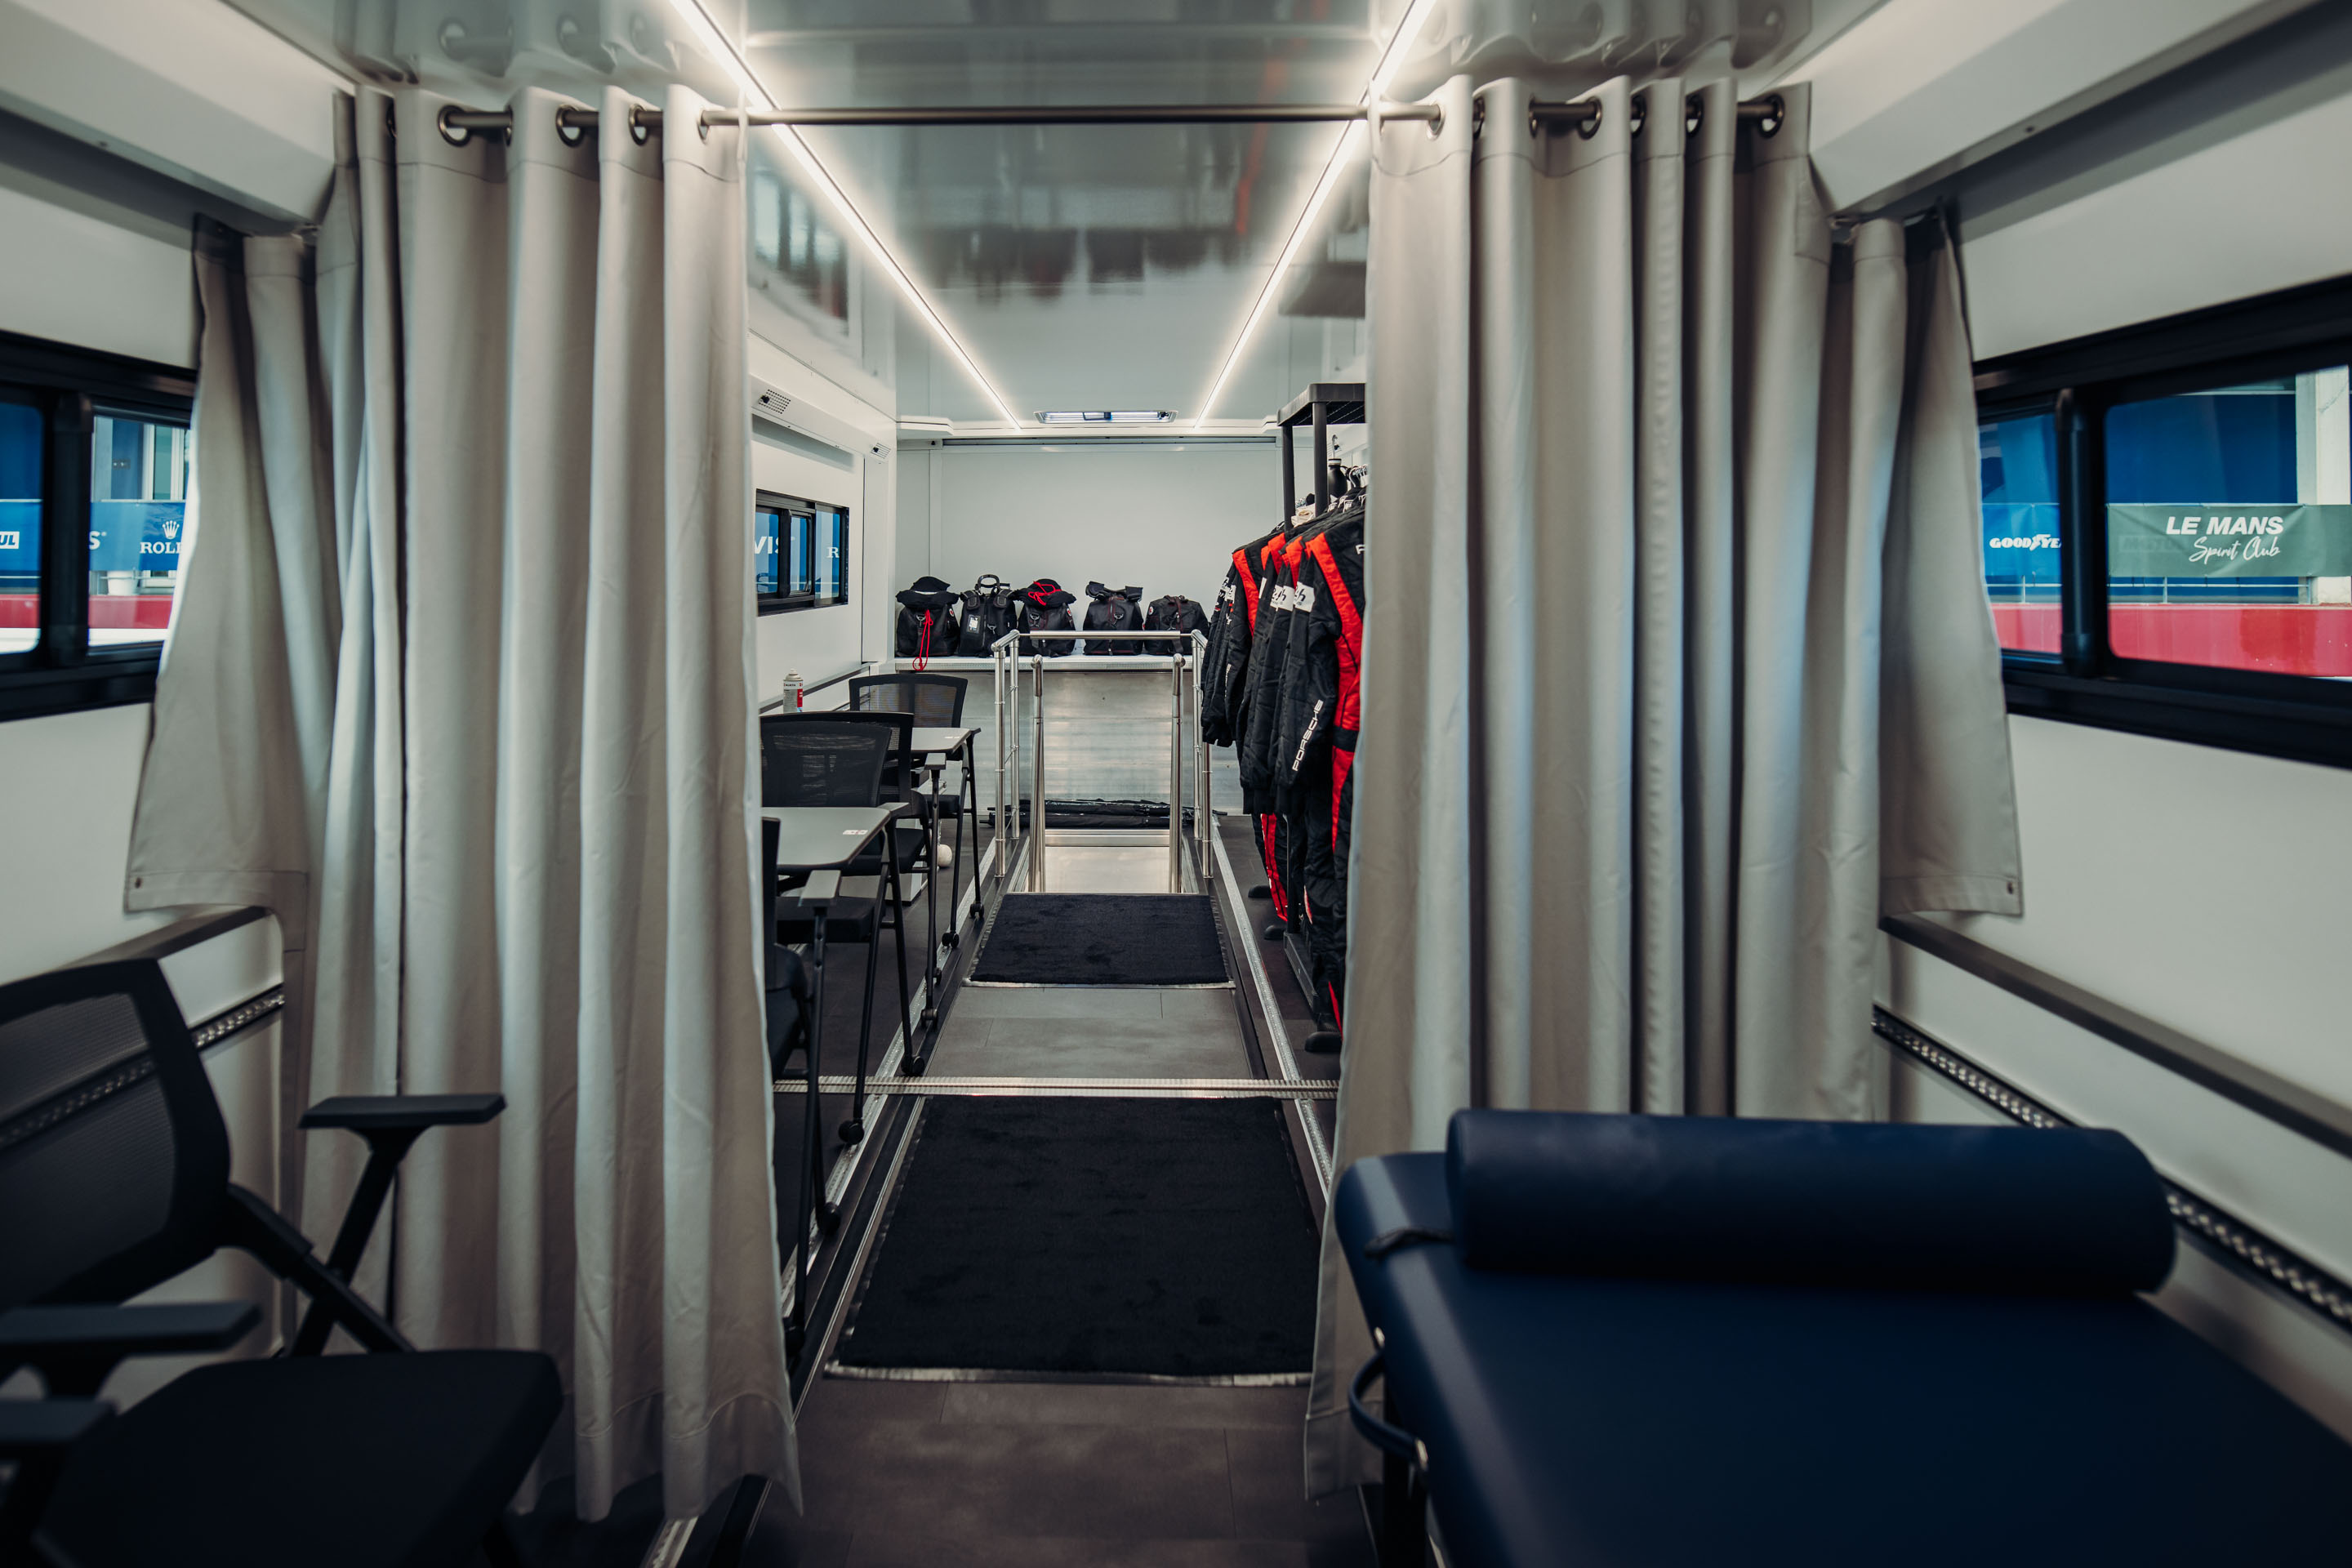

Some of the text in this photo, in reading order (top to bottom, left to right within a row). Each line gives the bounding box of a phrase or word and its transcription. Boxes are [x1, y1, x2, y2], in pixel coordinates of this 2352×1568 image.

[2166, 516, 2284, 535] LE MANS
[1989, 534, 2062, 551] GOODYE
[2189, 536, 2242, 564] Spirit
[2243, 536, 2280, 561] Club
[1292, 699, 1323, 771] PORSCHE
